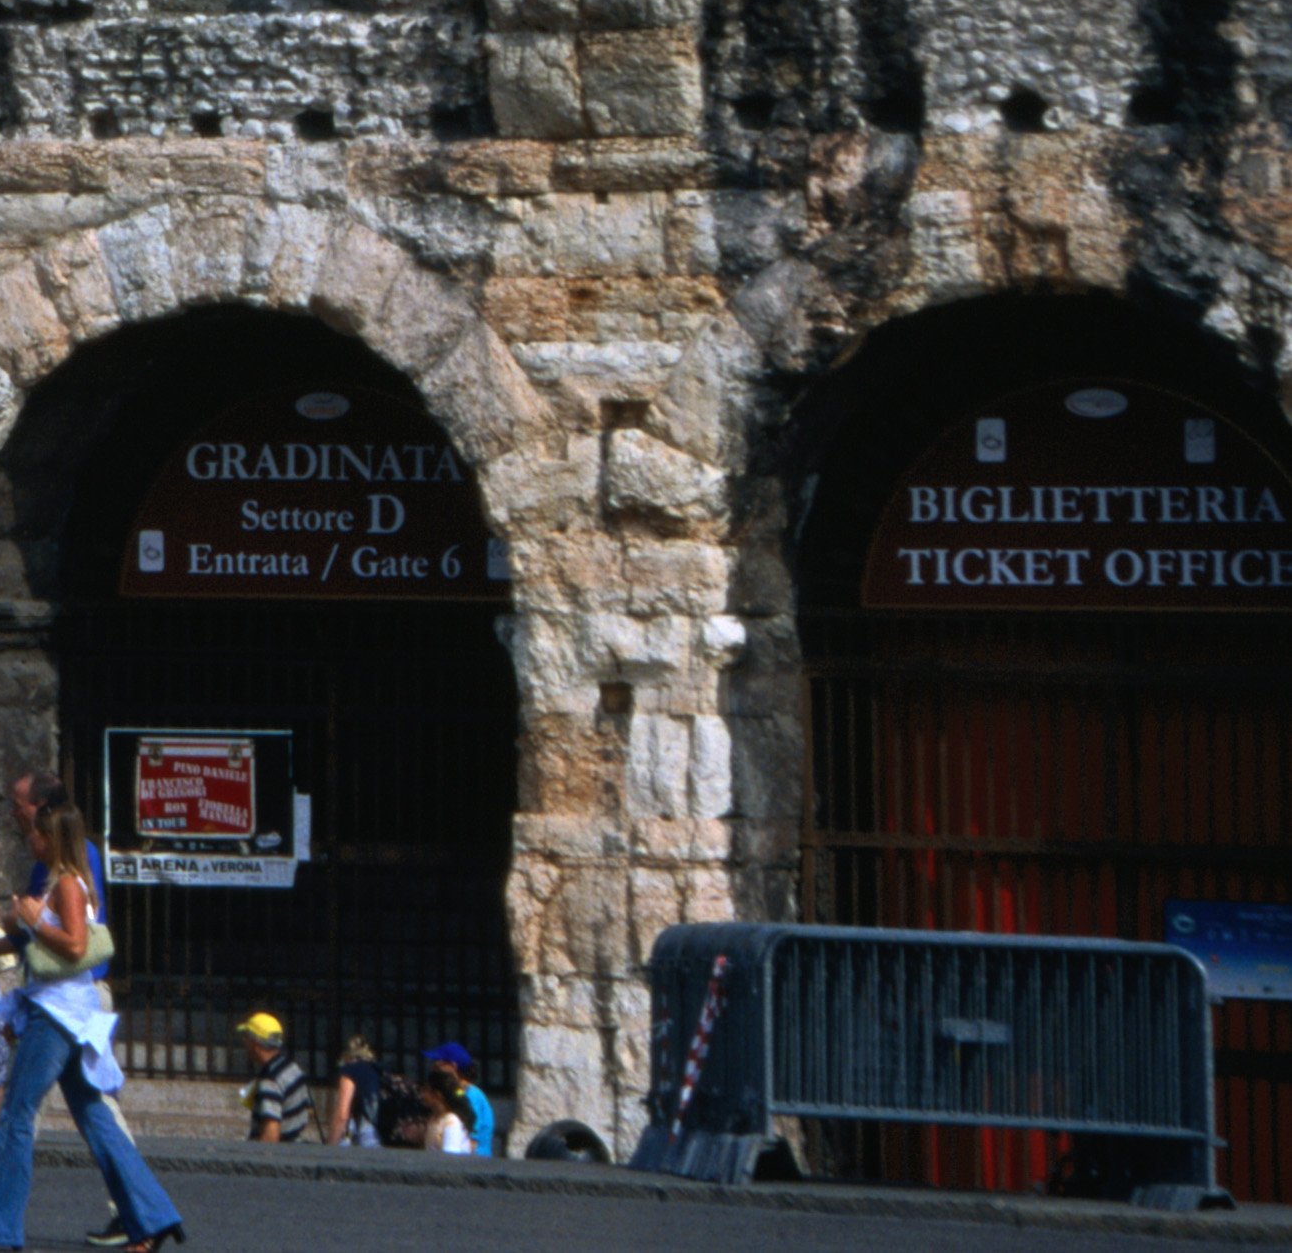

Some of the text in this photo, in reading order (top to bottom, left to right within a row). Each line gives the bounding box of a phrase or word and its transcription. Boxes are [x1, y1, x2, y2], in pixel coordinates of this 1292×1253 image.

[186, 444, 465, 481] GRADINATA
[241, 495, 405, 534] Settore D
[908, 485, 1285, 523] BIGLIETTERIA
[187, 543, 462, 582] Entrata / Gate 6
[898, 547, 1292, 587] TICKET OFFICE
[173, 761, 249, 782] PINO DANIELE
[140, 777, 205, 791] FRANCESCO
[140, 786, 207, 799] DE GREGORI
[163, 802, 188, 813] RON
[141, 817, 187, 829] IN TOUR
[140, 858, 199, 872] ARENA
[211, 860, 262, 873] VERONA
